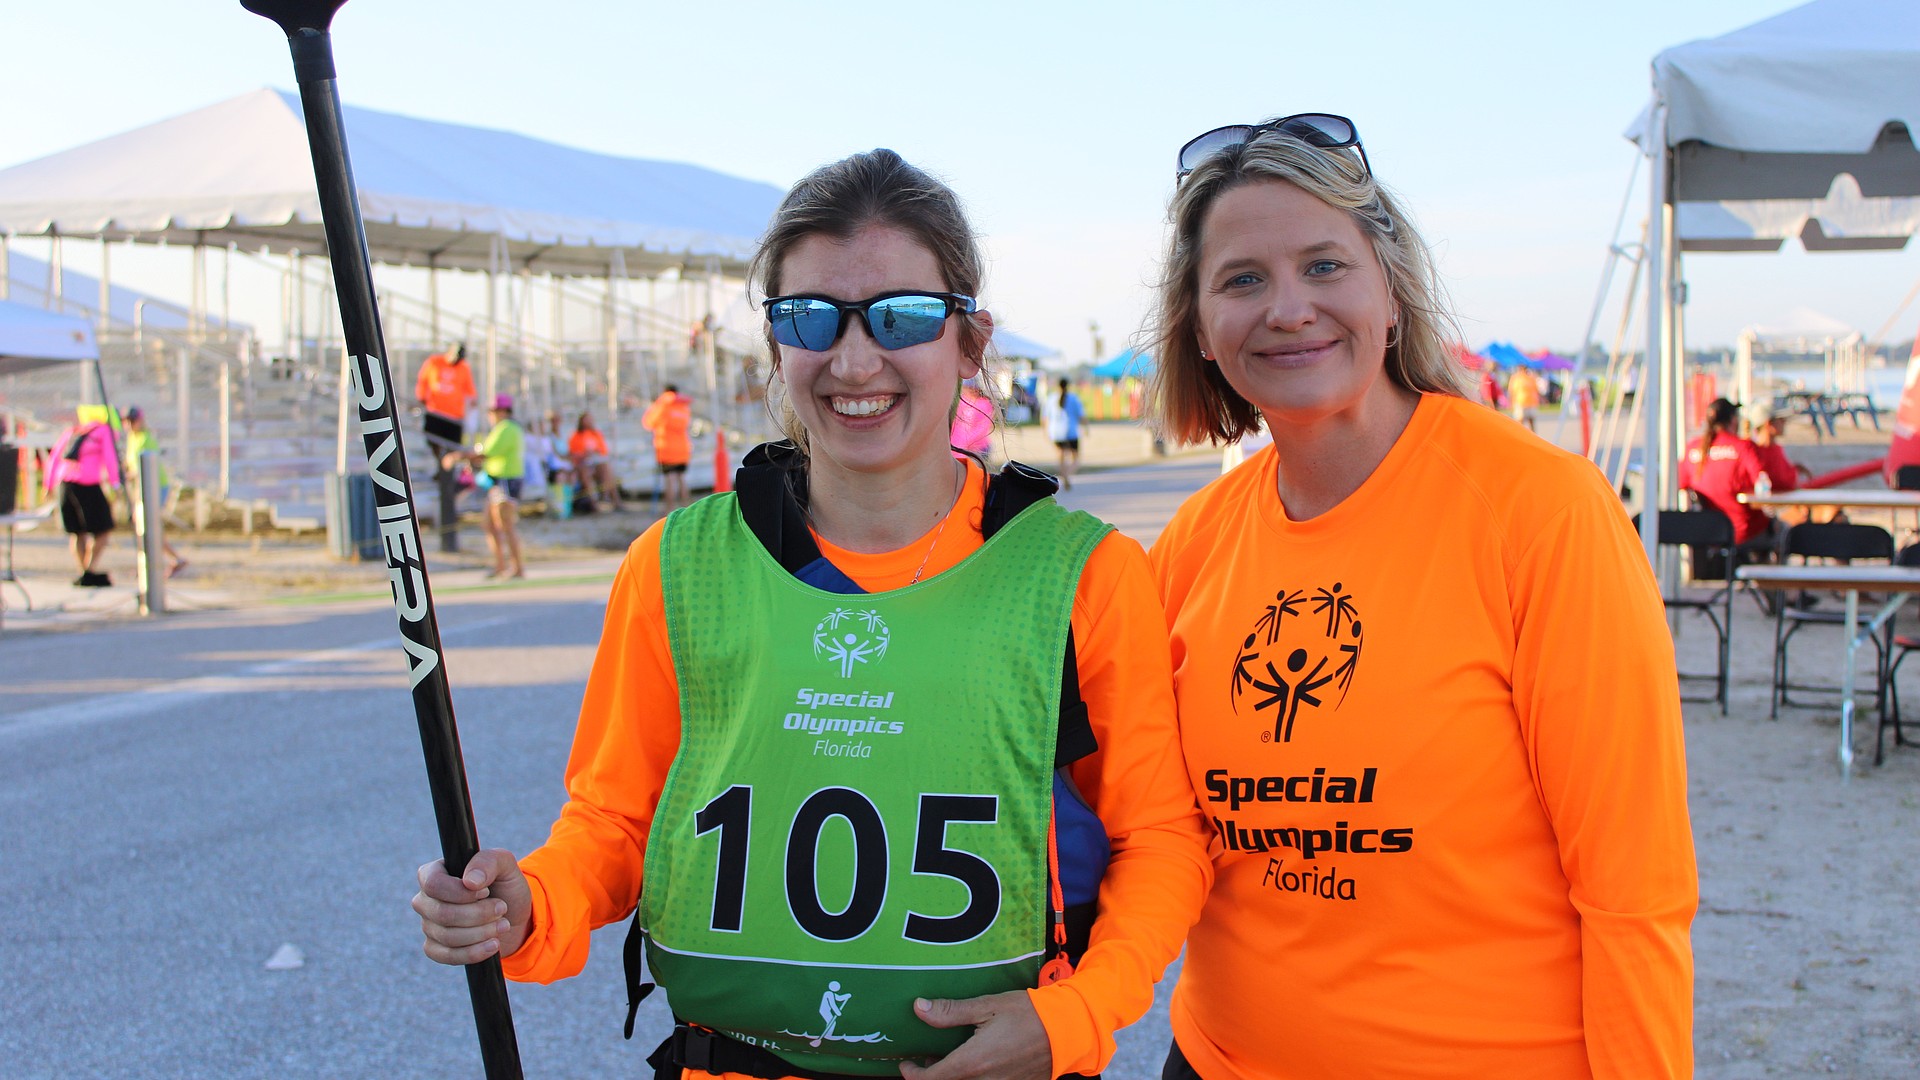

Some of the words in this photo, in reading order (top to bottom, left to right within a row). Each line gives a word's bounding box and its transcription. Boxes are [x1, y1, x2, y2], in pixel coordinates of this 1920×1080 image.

[795, 687, 895, 710] Special
[783, 712, 905, 737] Olympics
[813, 738, 872, 759] Florida
[1205, 767, 1378, 811] Special
[694, 783, 1002, 946] 105
[1263, 857, 1357, 901] Florida
